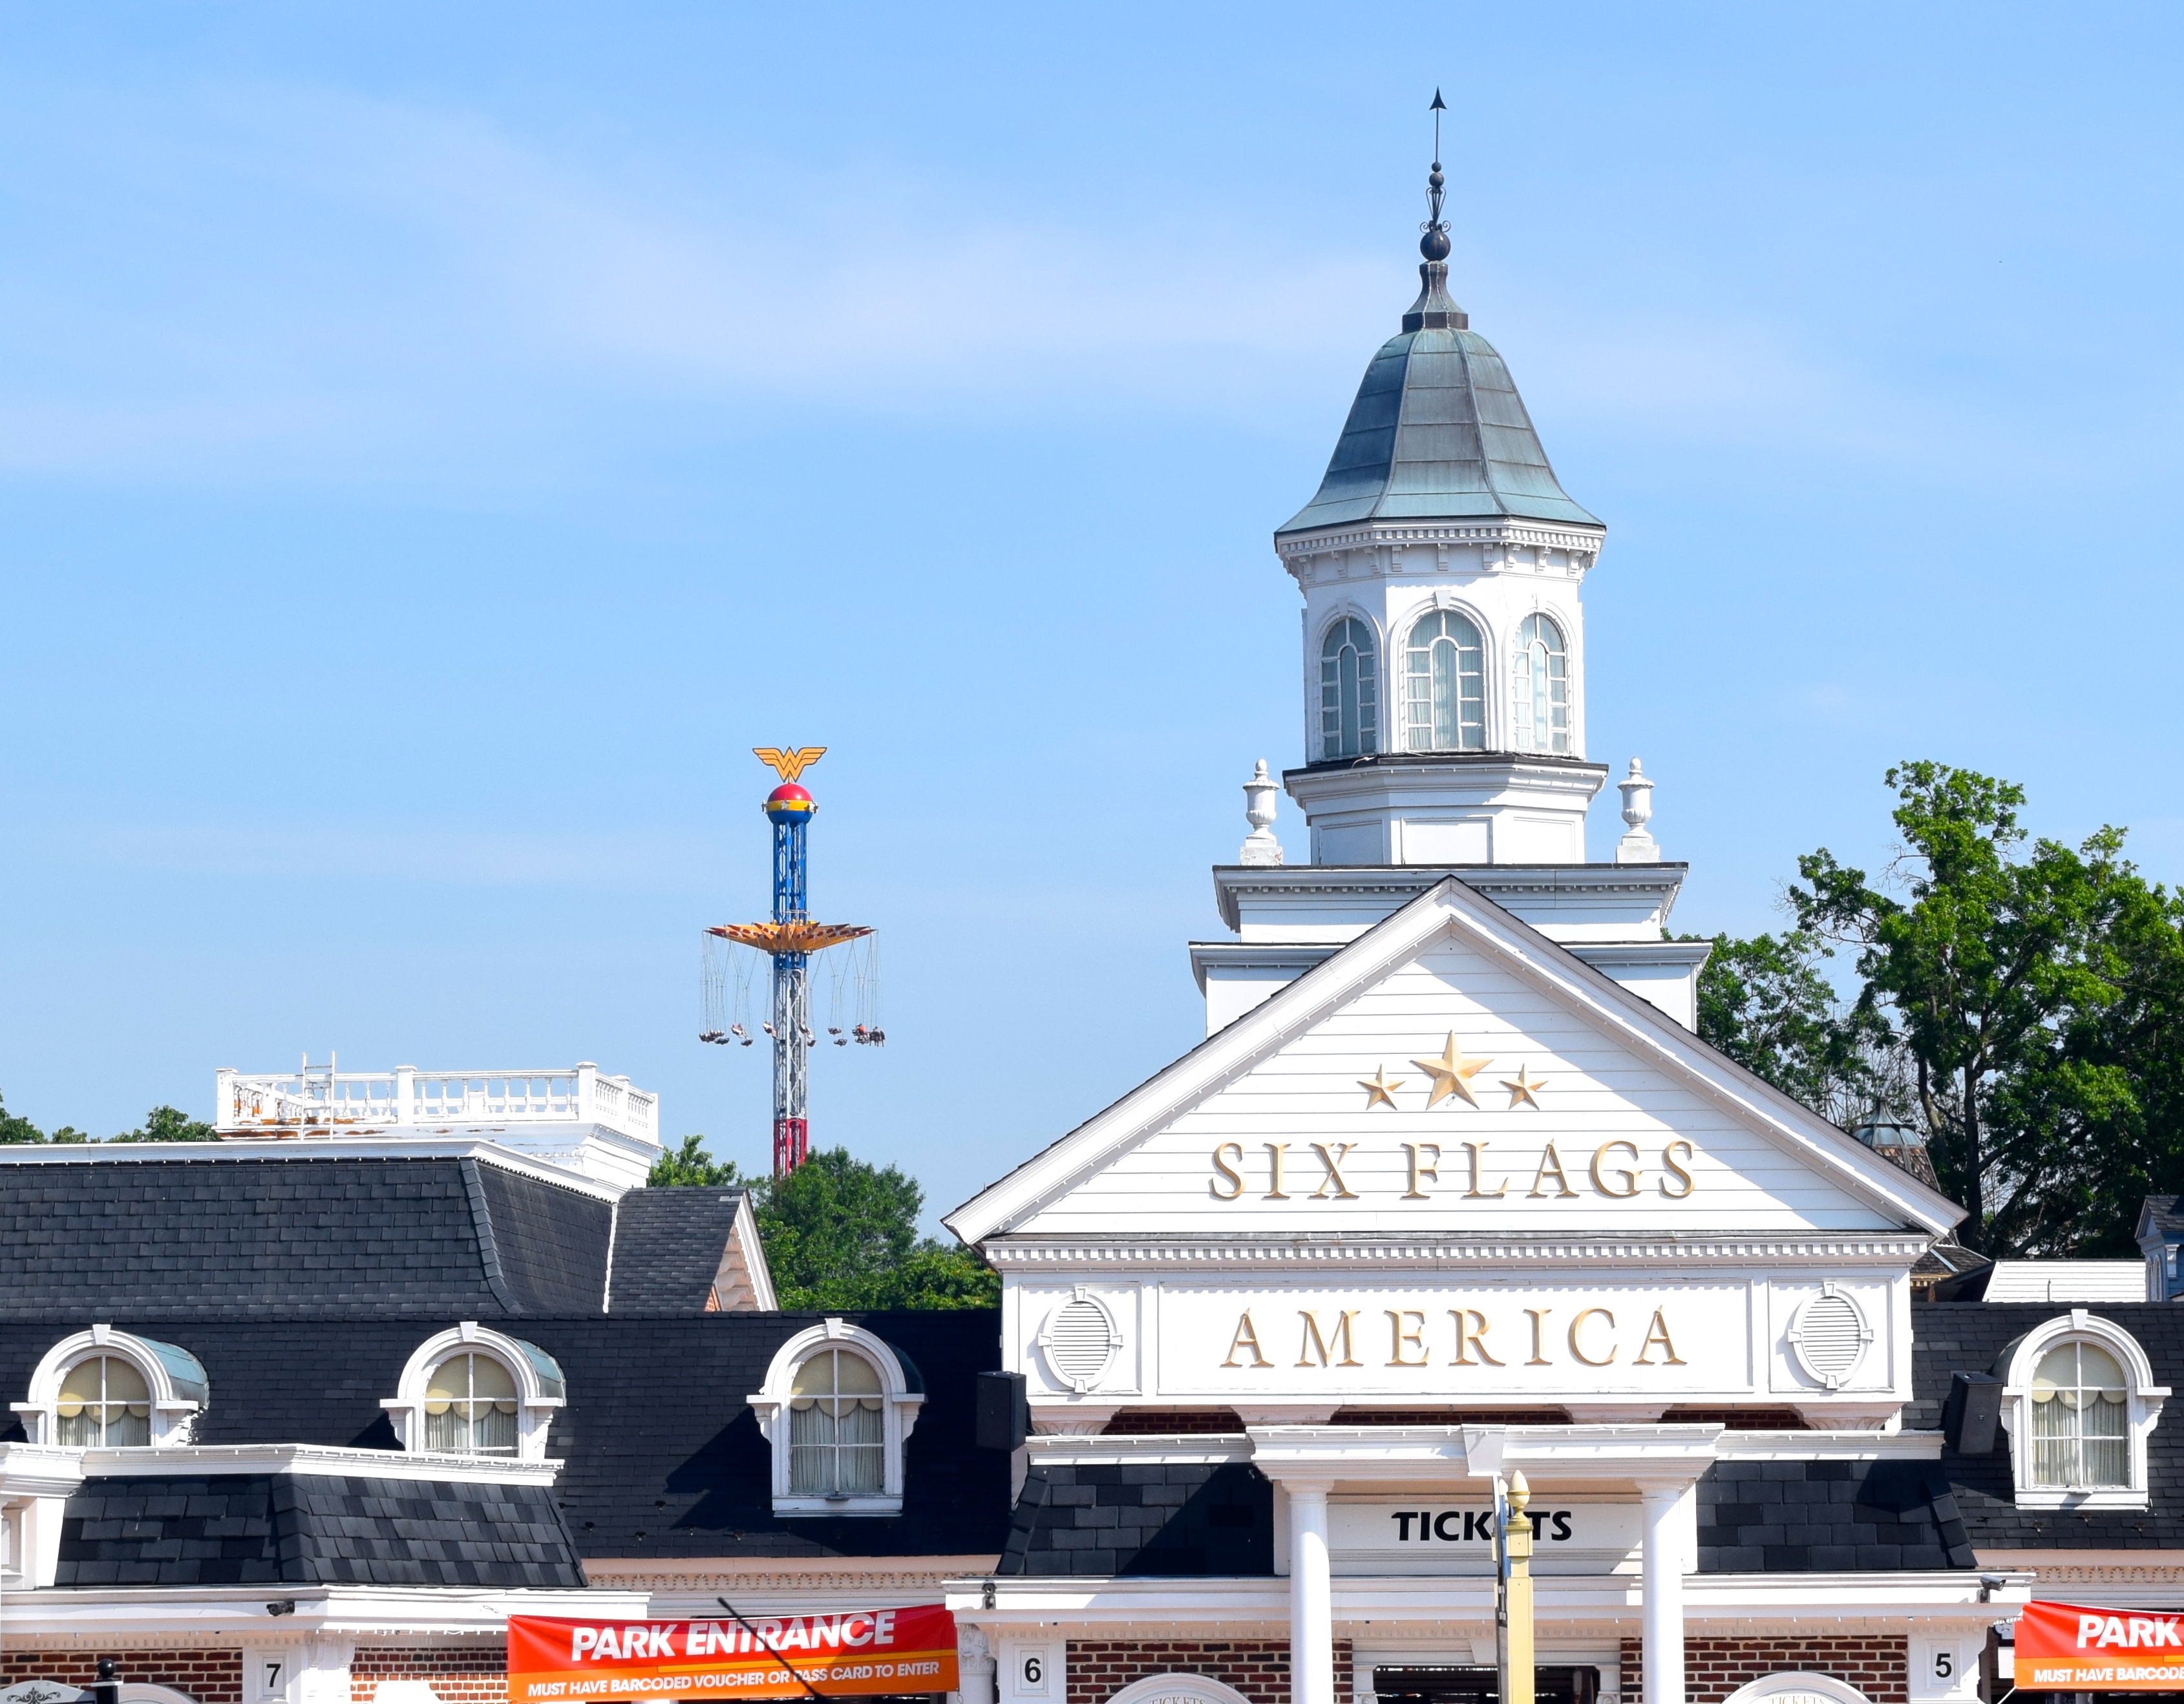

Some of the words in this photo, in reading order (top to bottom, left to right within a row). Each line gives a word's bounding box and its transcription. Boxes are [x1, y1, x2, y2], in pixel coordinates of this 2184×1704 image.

[1211, 1141, 1359, 1200] SIX
[1401, 1138, 1696, 1199] FLAGS
[1219, 1305, 1688, 1368] AMERICA
[1391, 1511, 1572, 1541] TICKTS
[572, 1624, 677, 1661] PARK
[686, 1611, 896, 1656] ENTRANCE
[2077, 1615, 2183, 1648] PARK
[266, 1663, 281, 1687] 7
[528, 1683, 566, 1696] MUST
[569, 1681, 608, 1694] HAVE
[610, 1676, 692, 1692] BARCODED
[694, 1672, 764, 1688] VOUCHER
[767, 1671, 790, 1685] OR
[793, 1668, 827, 1683] PASS
[831, 1665, 873, 1680] CARD
[875, 1664, 894, 1678] TO
[898, 1661, 939, 1676] ENTER
[1024, 1657, 1041, 1683] 6
[1935, 1653, 1952, 1678] 5
[2034, 1669, 2073, 1683] MUST
[2075, 1668, 2114, 1681] HAVE
